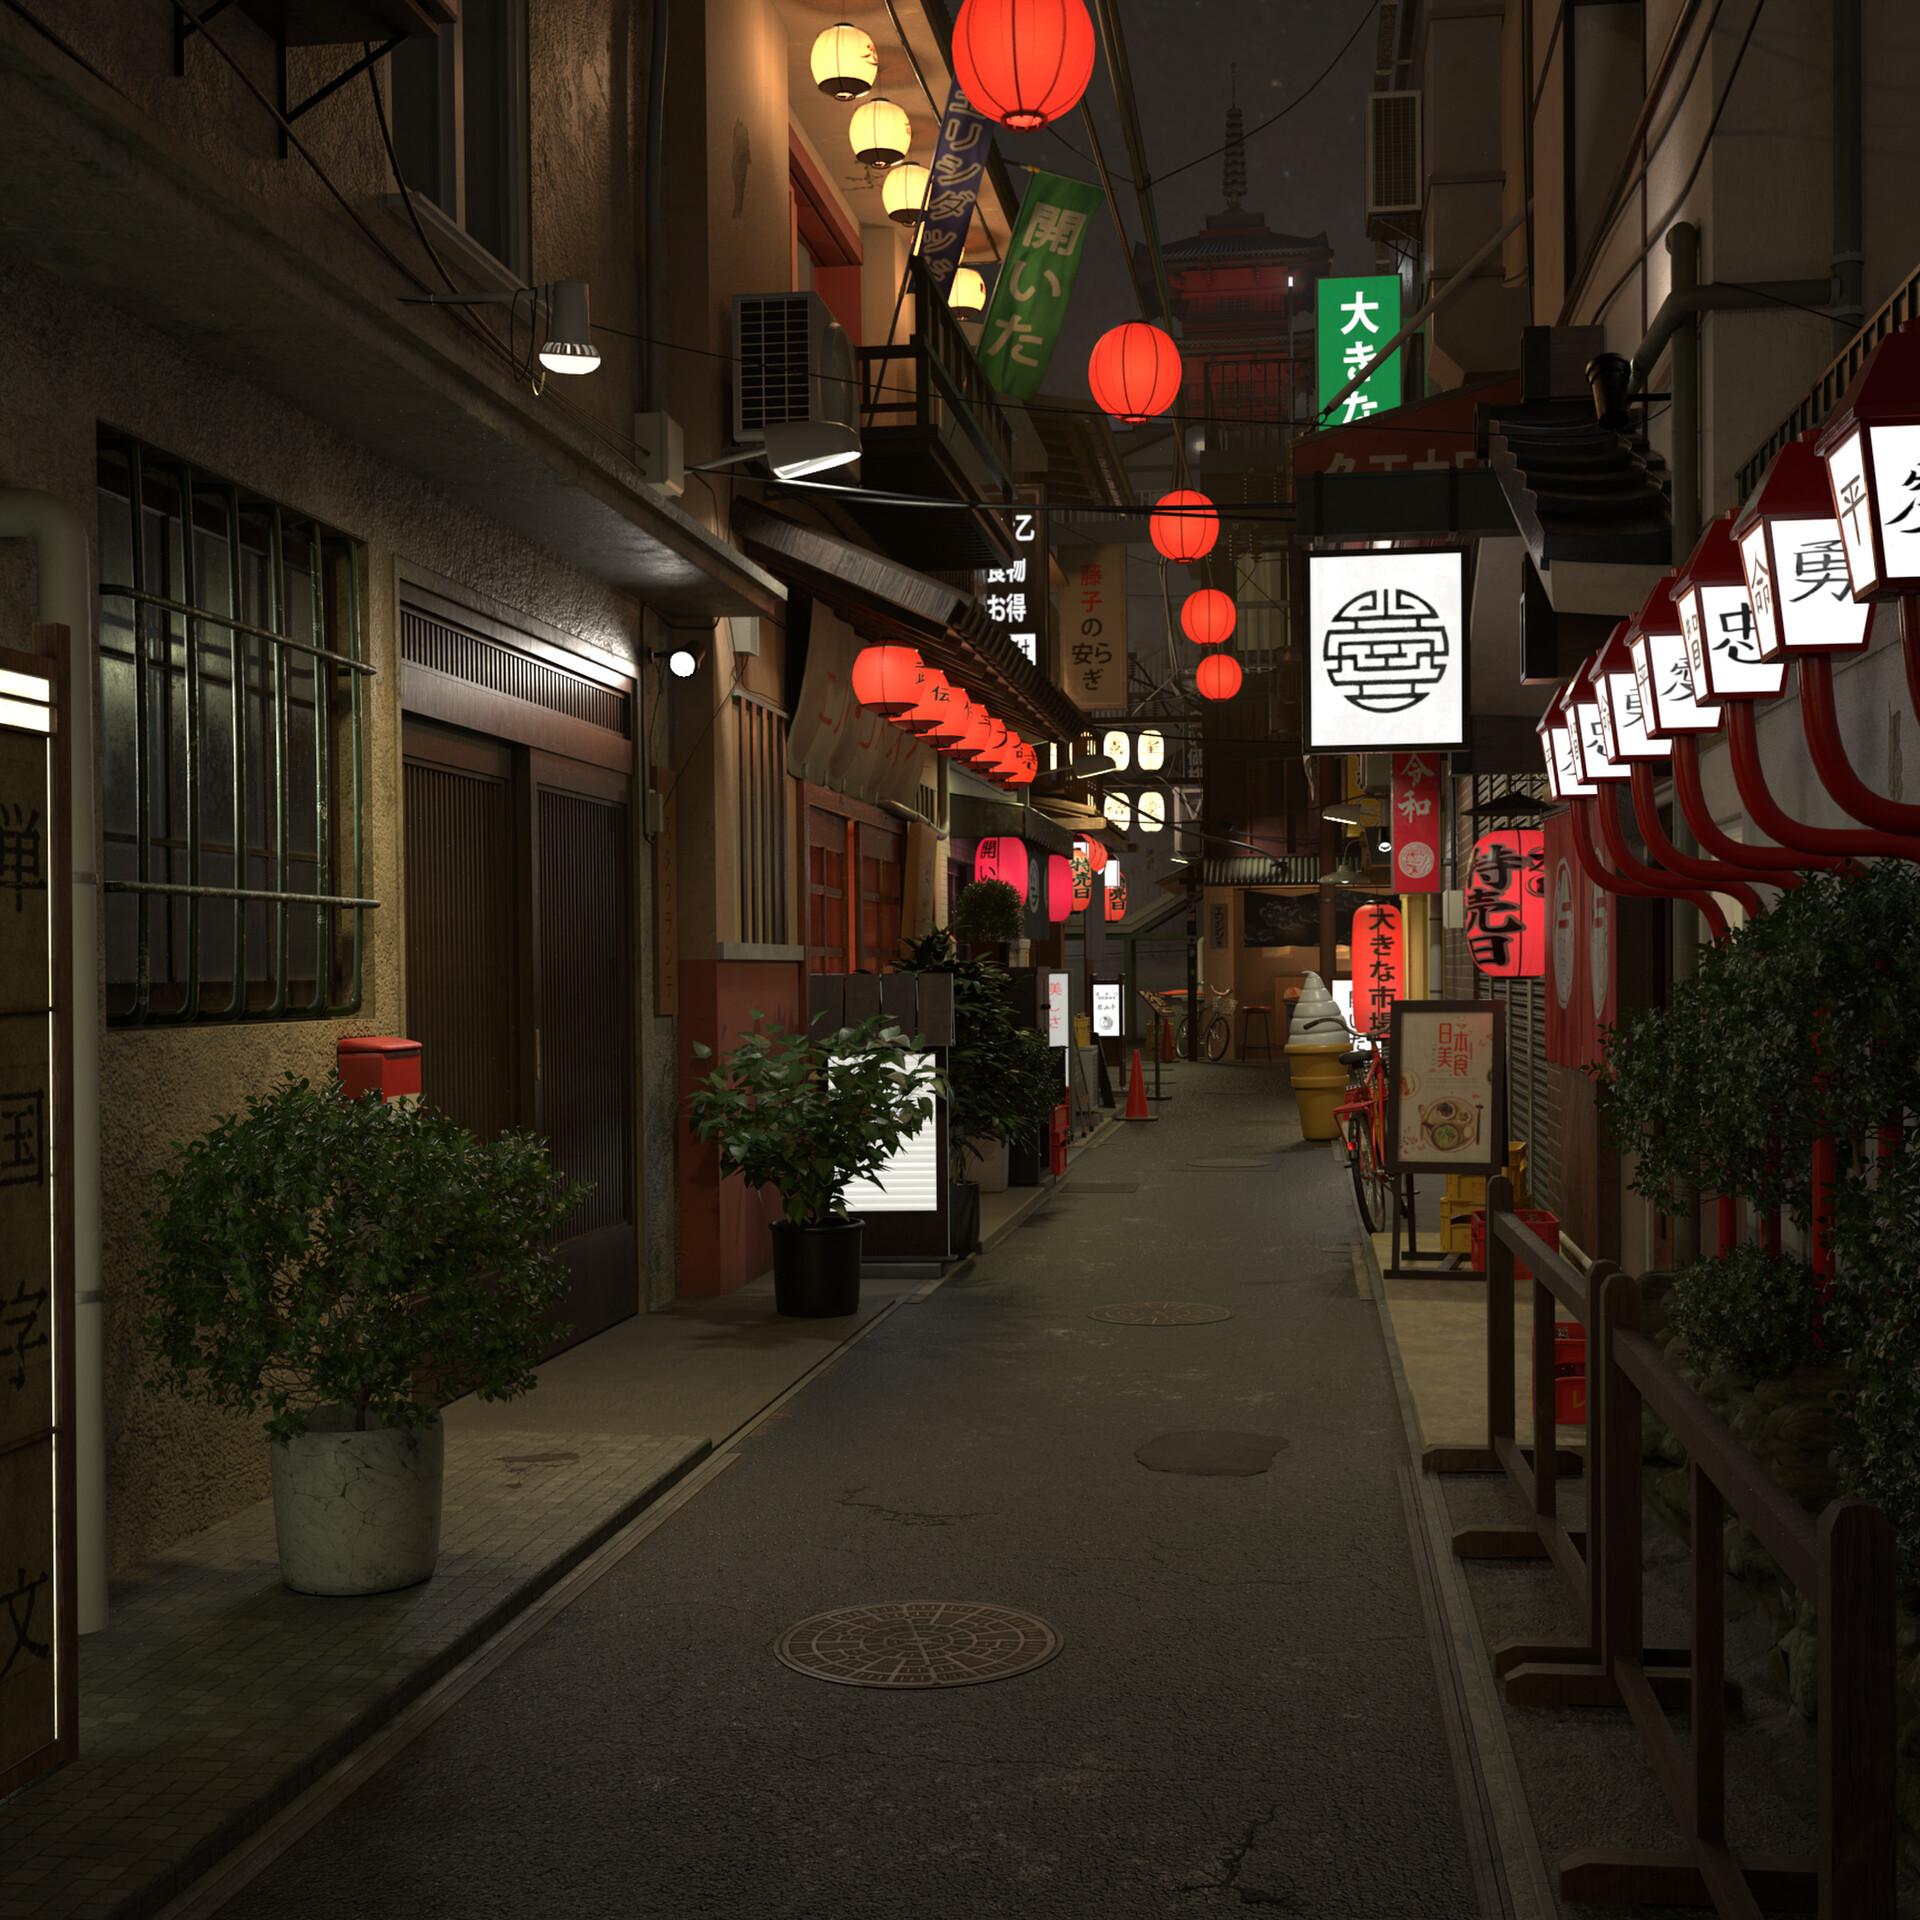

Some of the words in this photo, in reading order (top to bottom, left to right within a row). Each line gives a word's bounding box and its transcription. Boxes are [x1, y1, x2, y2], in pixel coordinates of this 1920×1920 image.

[986, 202, 1088, 368] 開いた
[1340, 291, 1379, 424] 大きな
[987, 593, 1026, 622] お得
[1789, 540, 1851, 602] 勇
[1397, 753, 1435, 823] 令和
[1368, 908, 1396, 1031] 大きな市場
